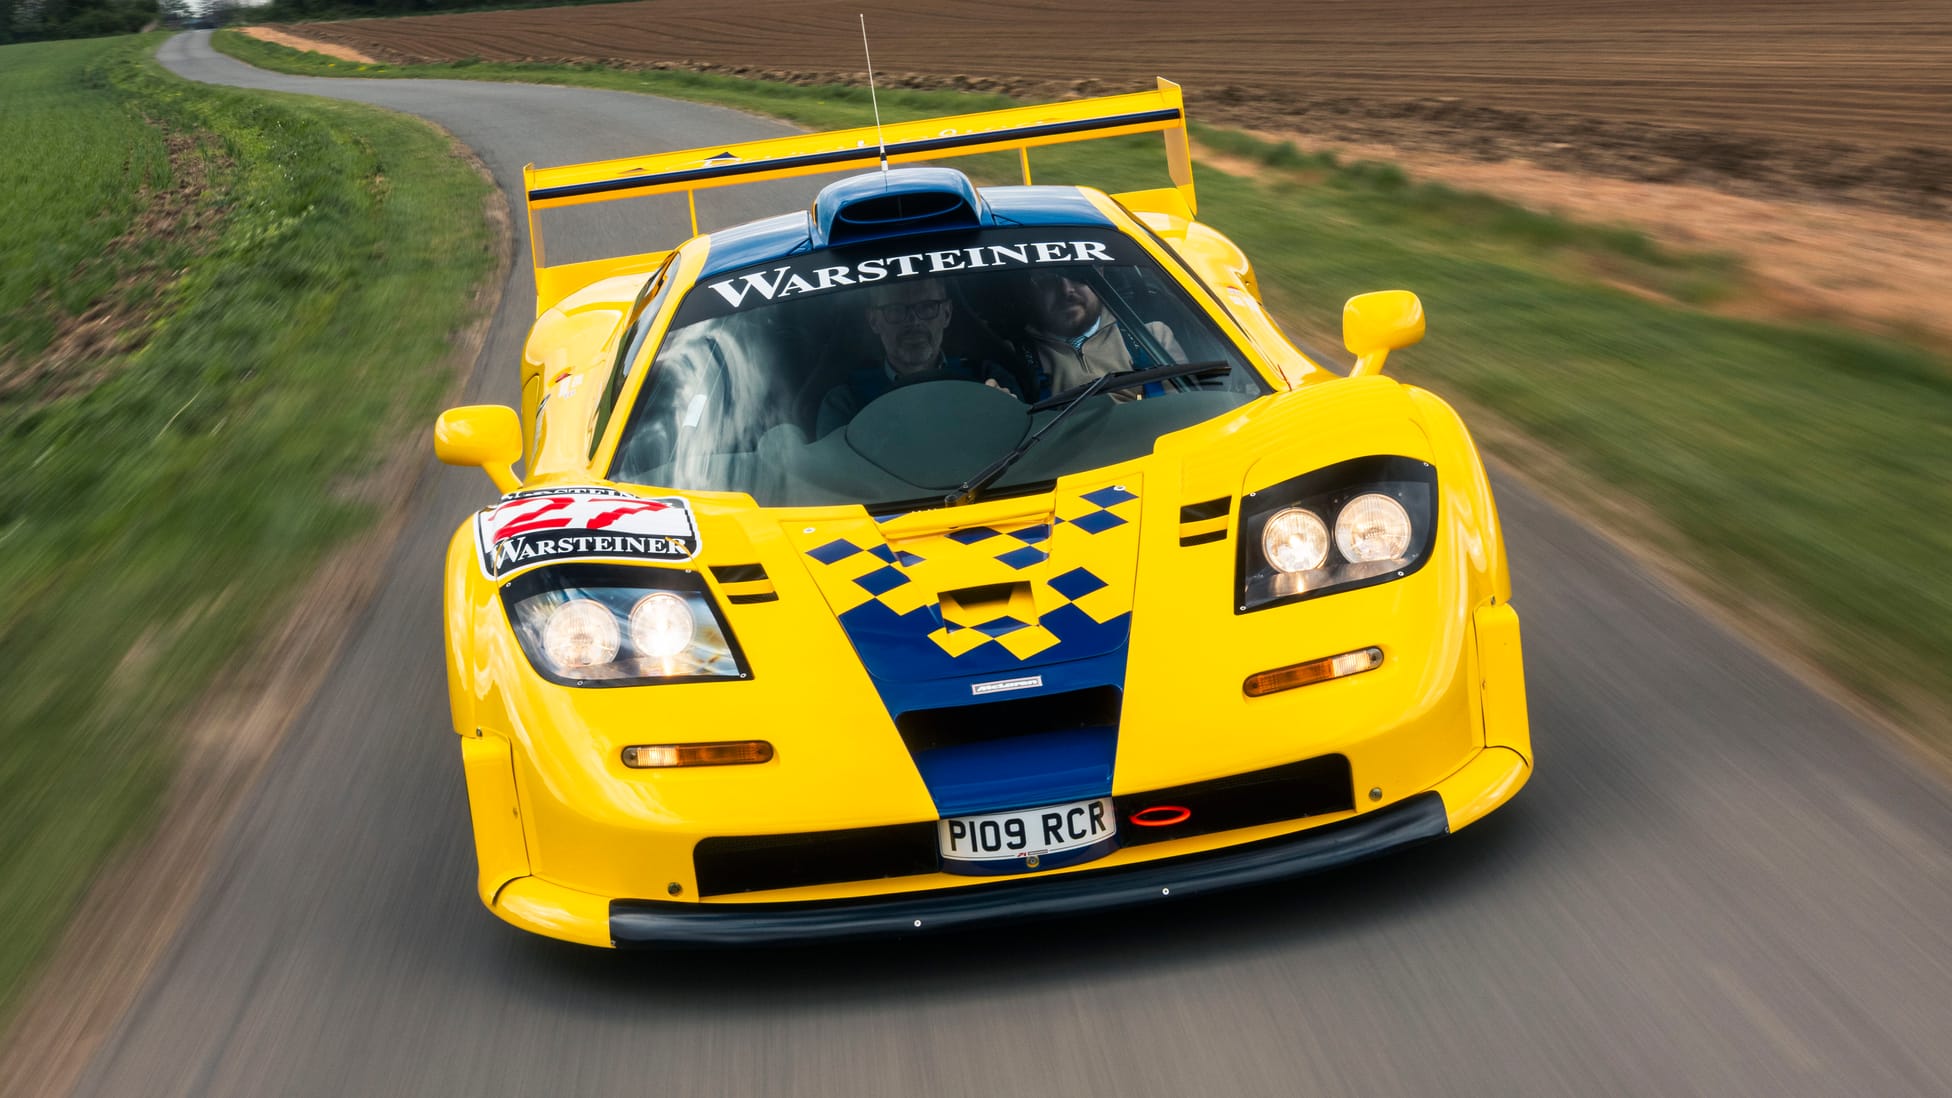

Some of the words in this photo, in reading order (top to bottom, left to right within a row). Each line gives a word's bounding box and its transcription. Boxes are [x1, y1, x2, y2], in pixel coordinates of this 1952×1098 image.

[708, 241, 1115, 308] WARSTEINER
[488, 497, 671, 545] 27
[491, 536, 687, 569] WARSTEINER
[948, 818, 1027, 852] P109
[1041, 801, 1107, 846] RCR
